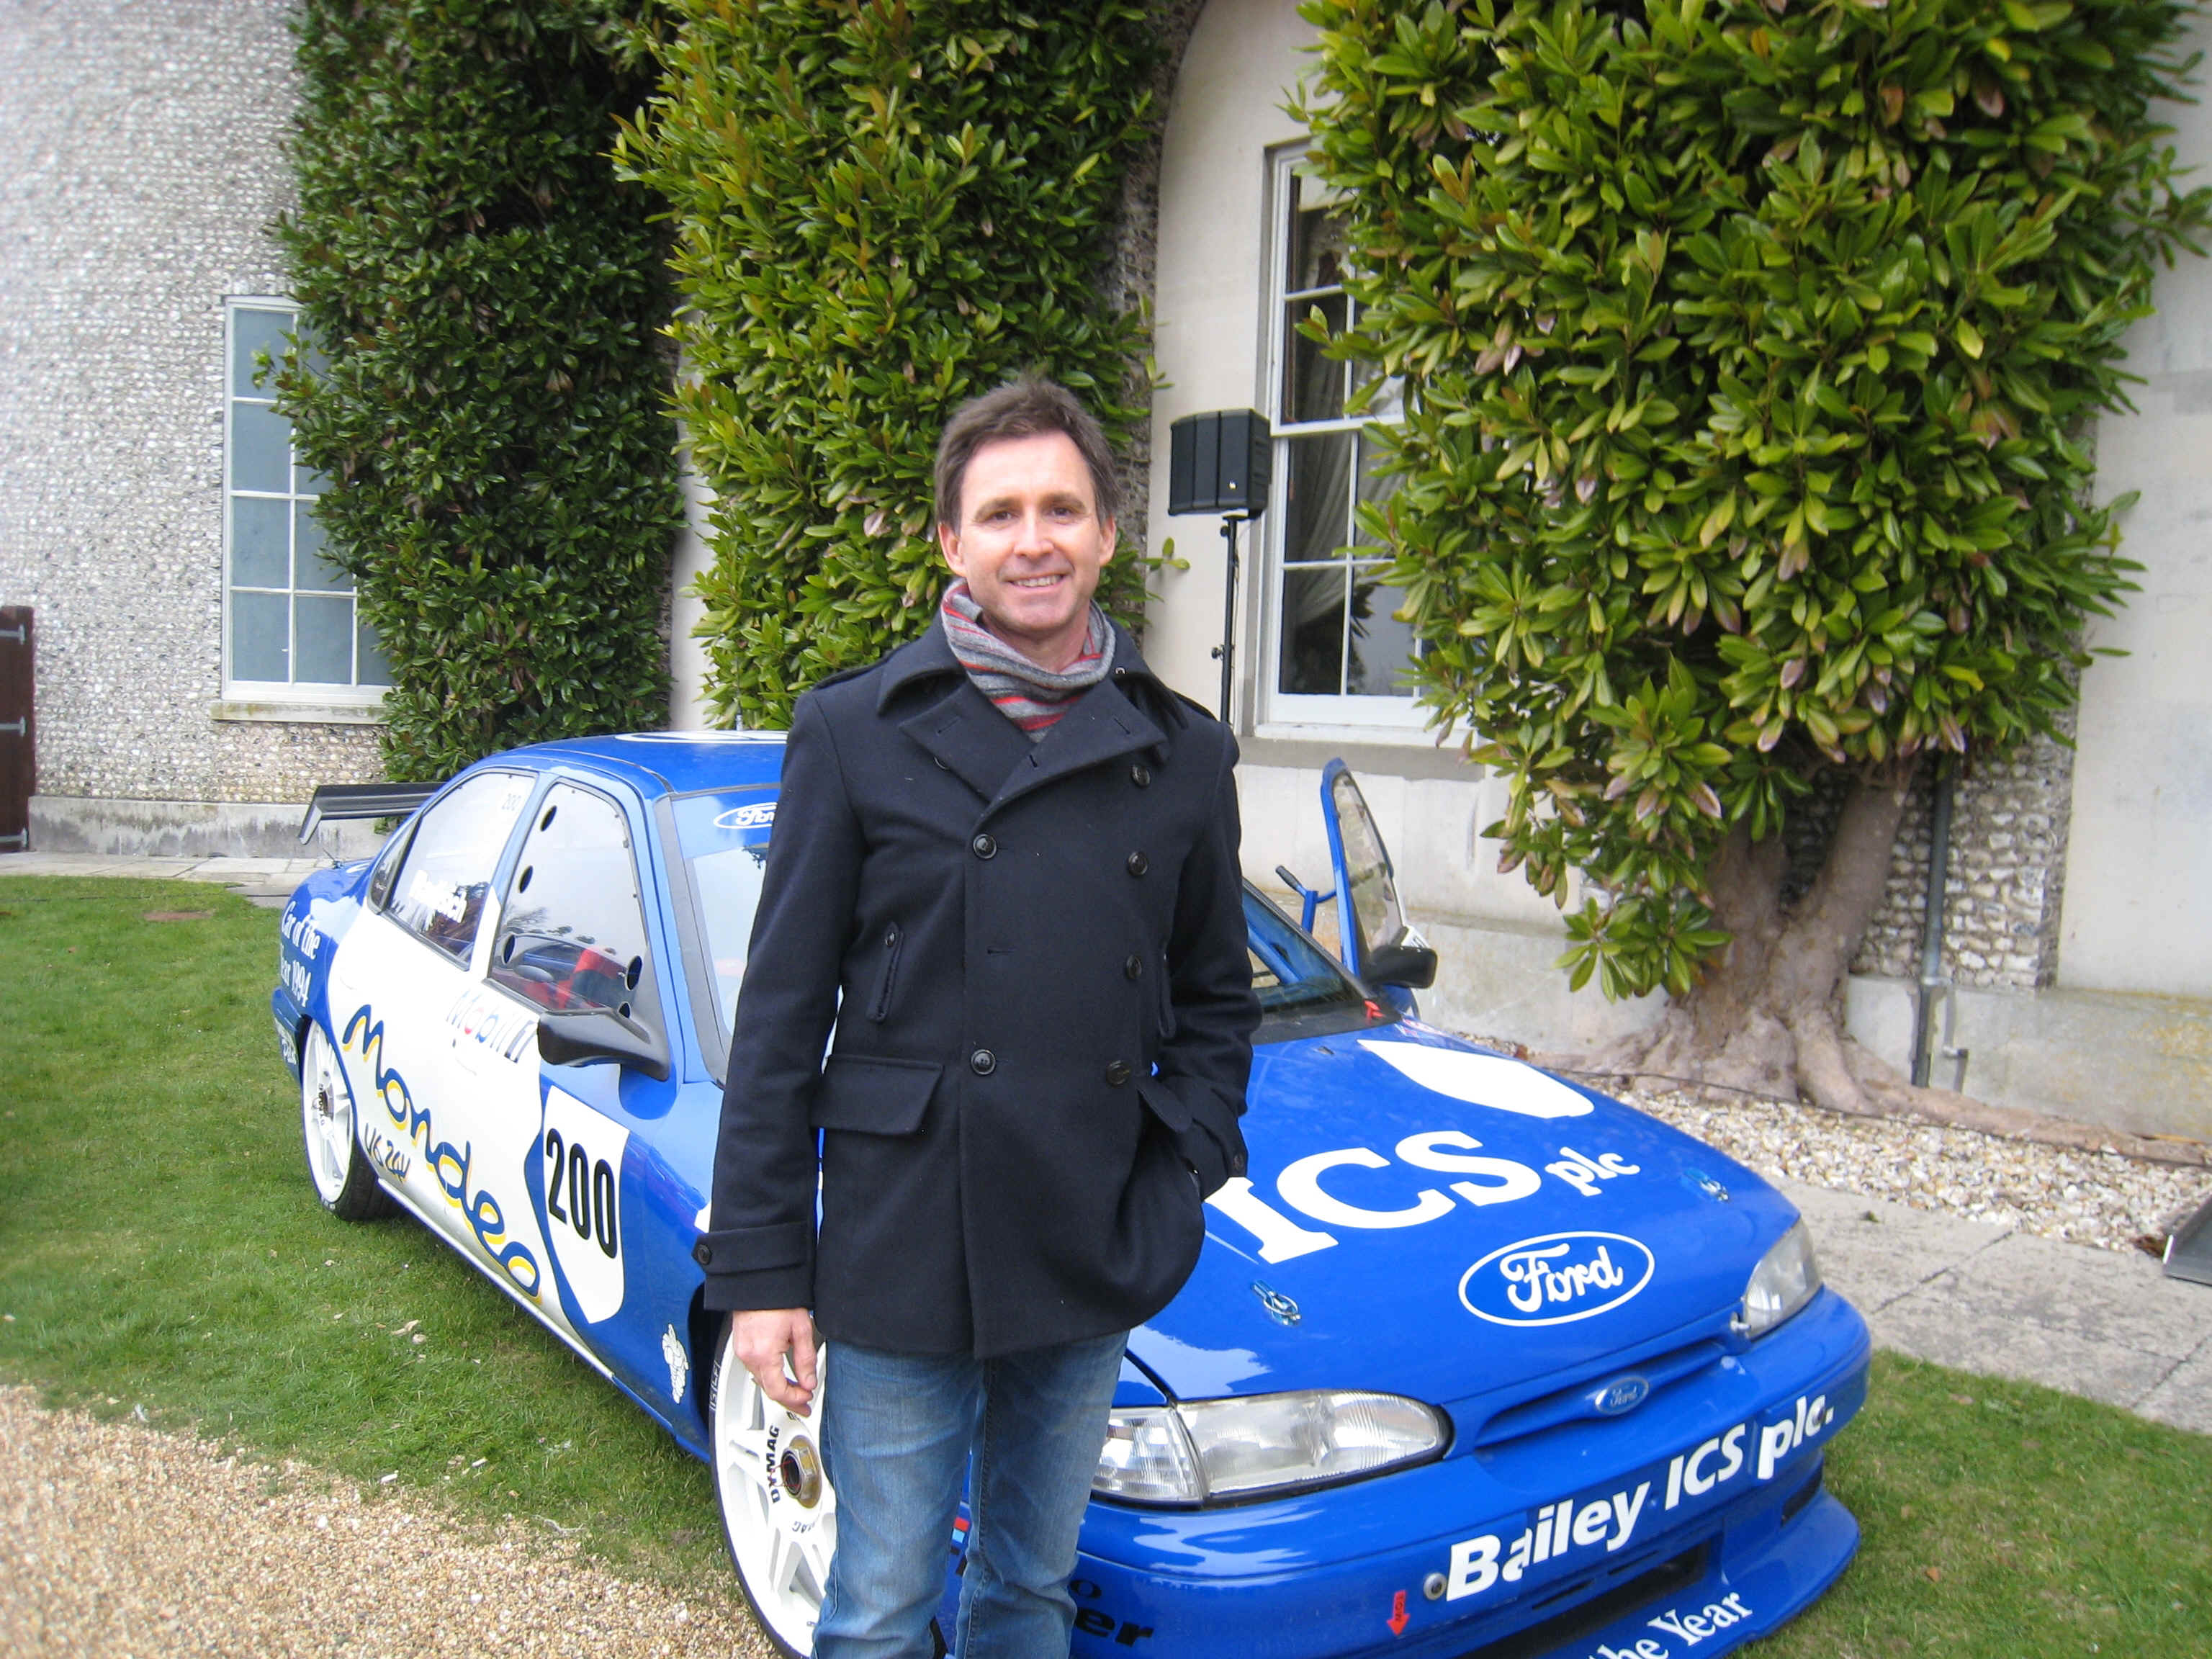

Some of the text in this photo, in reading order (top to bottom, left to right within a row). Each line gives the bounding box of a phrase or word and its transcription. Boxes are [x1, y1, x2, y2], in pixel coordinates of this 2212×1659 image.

[736, 805, 776, 826] For
[282, 901, 296, 939] Car
[292, 914, 311, 948] of
[292, 959, 312, 1007] 1994
[342, 1004, 541, 1302] Mondeo
[547, 1128, 618, 1259] 200
[1204, 1130, 1641, 1264] ICS plc
[1500, 1243, 1624, 1313] Ford
[766, 1425, 781, 1503] DYMAG
[1446, 1481, 1650, 1602] Bailey
[1665, 1422, 1746, 1511] ICS
[1588, 1592, 1753, 1659] he Year
